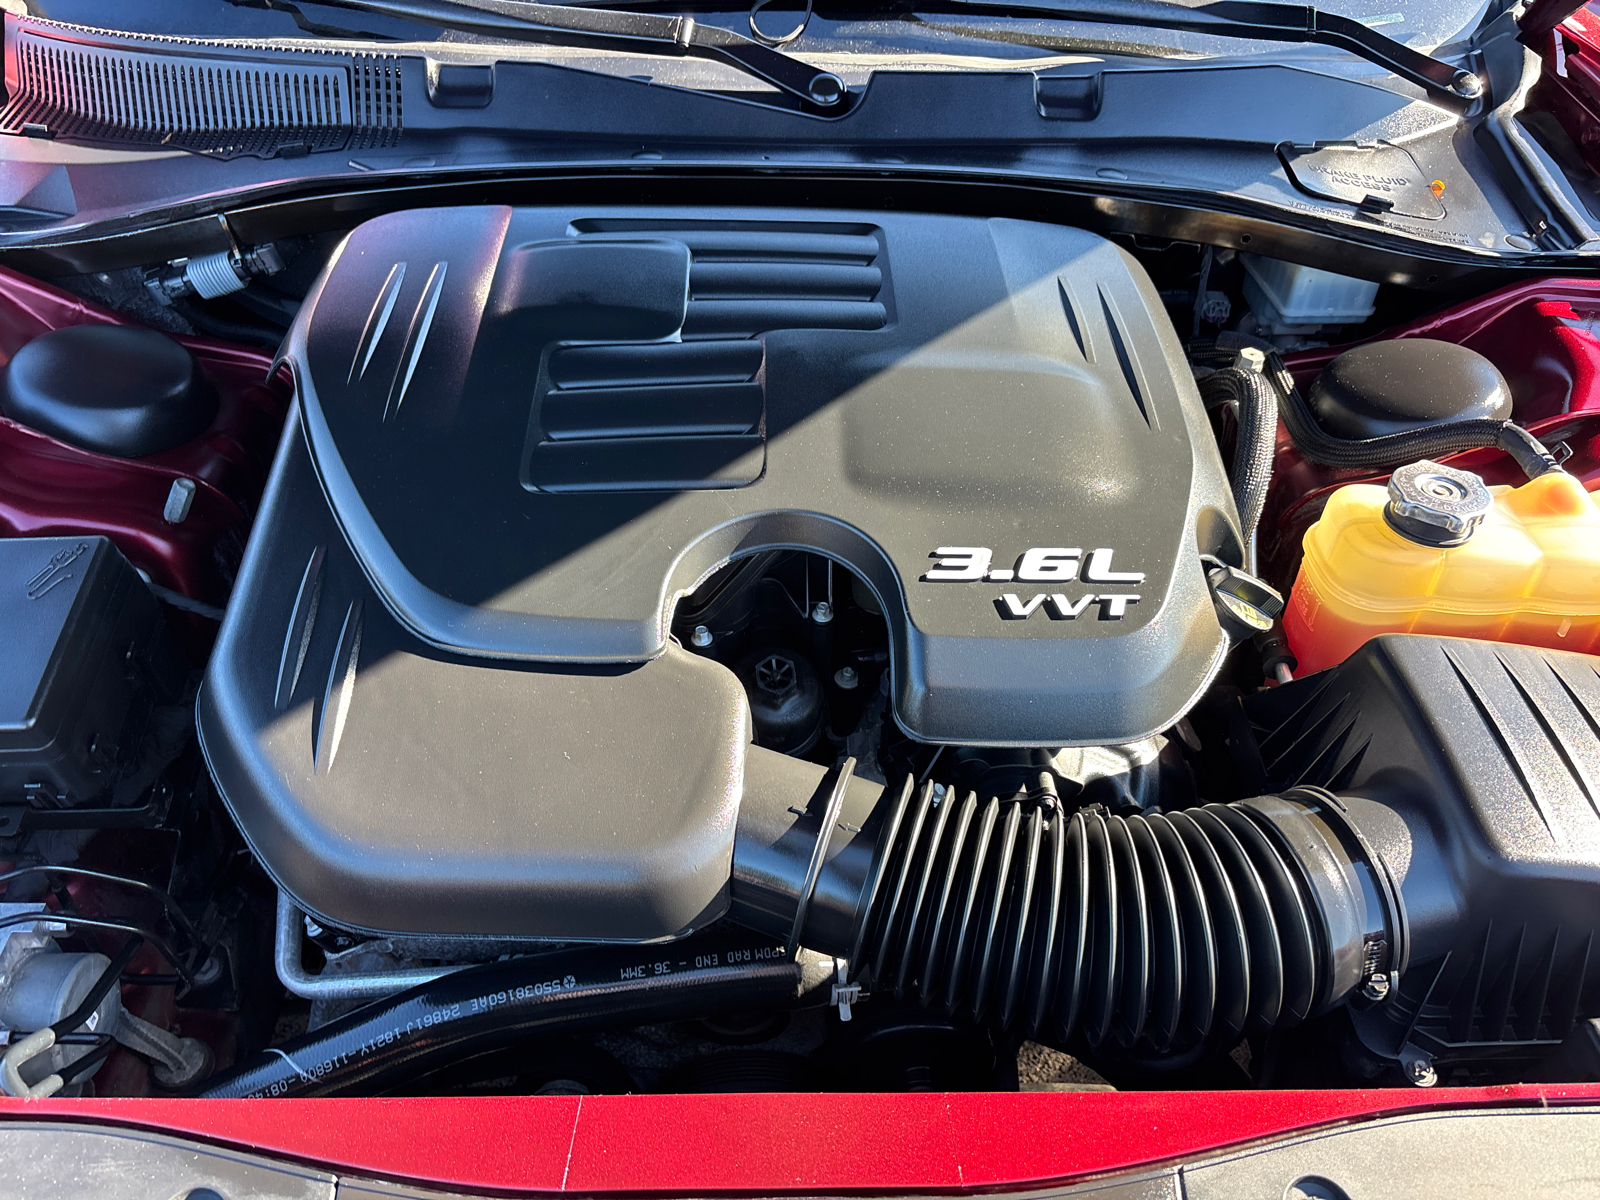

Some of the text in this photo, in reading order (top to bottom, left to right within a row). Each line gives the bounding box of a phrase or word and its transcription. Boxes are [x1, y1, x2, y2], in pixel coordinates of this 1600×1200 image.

[1331, 176, 1392, 192] ACCESS
[1363, 173, 1407, 187] FLUID
[920, 547, 1146, 583] 3.6L
[995, 593, 1141, 620] VVT
[695, 953, 718, 968] END
[727, 949, 750, 963] RAD
[620, 961, 671, 979] 36.3MM
[470, 979, 561, 1012] 55038160AE
